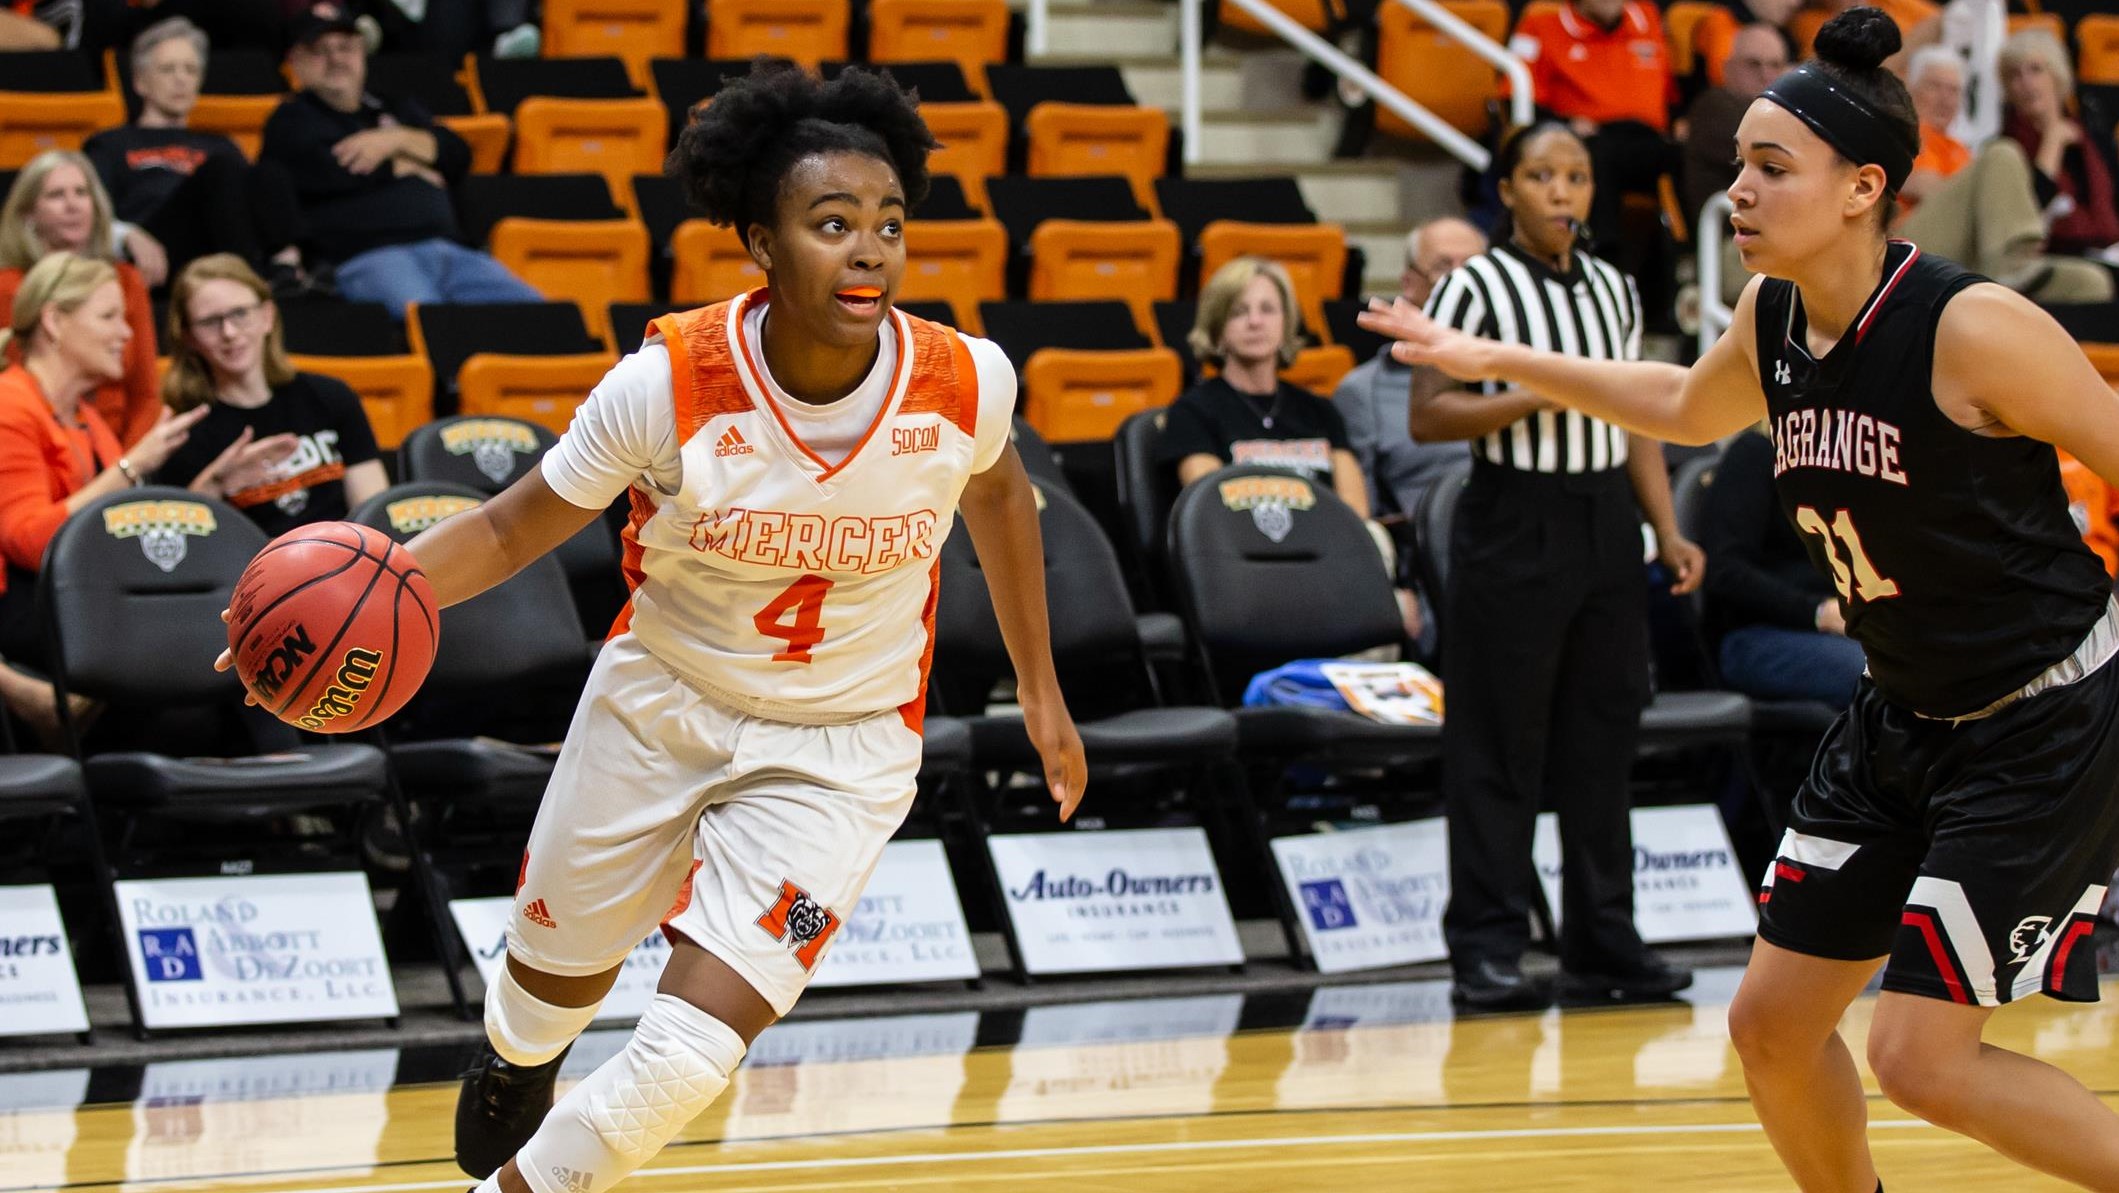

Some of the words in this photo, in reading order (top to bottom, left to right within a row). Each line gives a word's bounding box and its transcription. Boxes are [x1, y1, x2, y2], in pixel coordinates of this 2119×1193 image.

[715, 444, 754, 457] adidas
[892, 422, 941, 456] SOCON
[1769, 407, 1909, 486] AGRANGE
[688, 507, 938, 575] MERCER
[753, 573, 835, 664] 4
[1010, 868, 1215, 901] Auto-Owners
[523, 908, 557, 929] adidas
